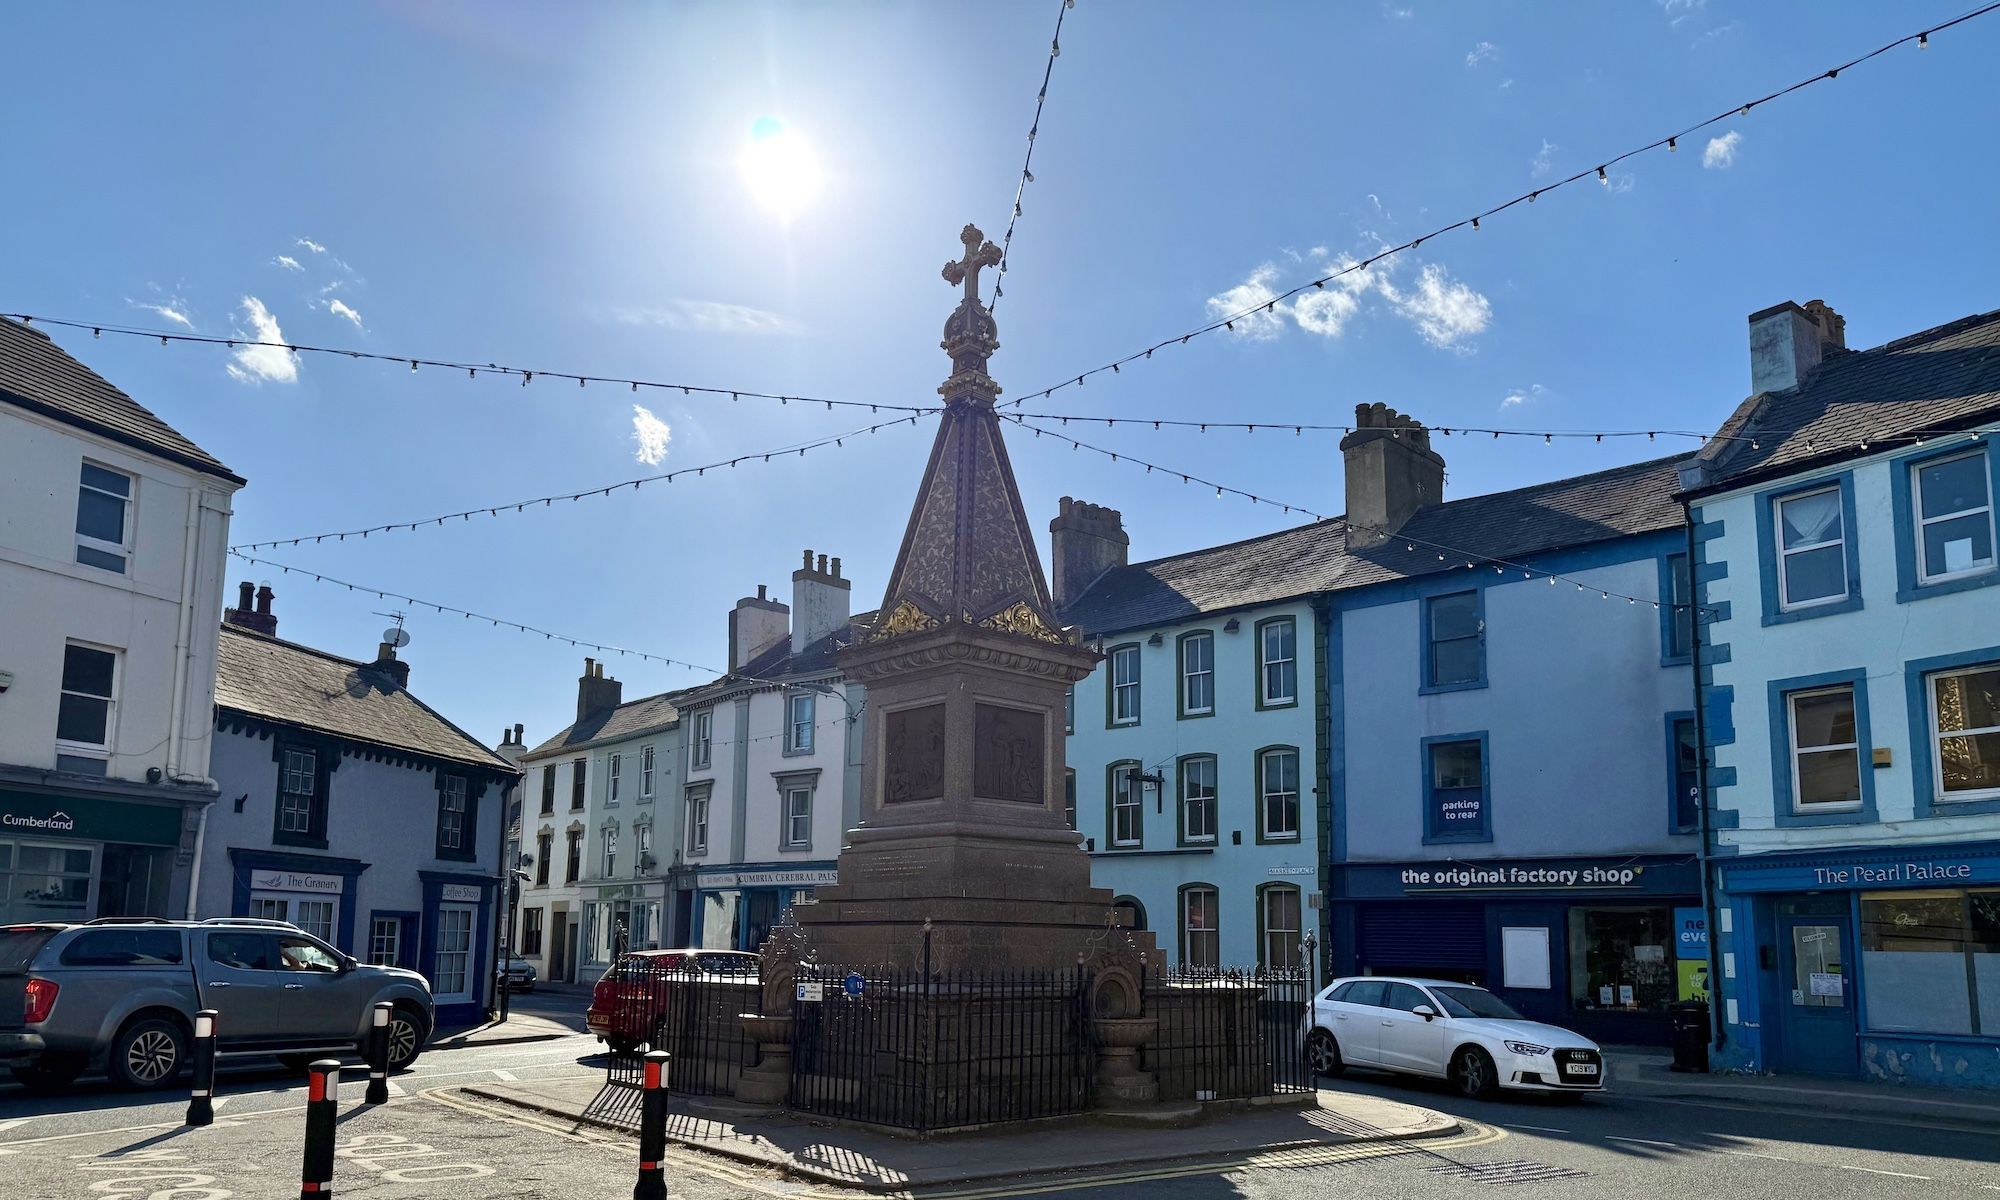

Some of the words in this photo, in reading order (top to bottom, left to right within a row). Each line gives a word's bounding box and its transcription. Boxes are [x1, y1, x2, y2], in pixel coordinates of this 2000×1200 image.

[1442, 800, 1480, 811] parking
[1445, 811, 1456, 820] to
[1457, 811, 1478, 819] rear
[2, 814, 74, 830] Cumberland
[739, 872, 773, 883] CUMBRIA
[775, 872, 815, 882] CEREBRAL
[818, 872, 839, 881] PALS
[1401, 869, 1430, 884] the
[1434, 868, 1507, 887] original
[1510, 867, 1578, 885] factory
[1582, 867, 1634, 885] shop
[1813, 867, 1849, 884] The
[1852, 864, 1901, 882] Pearl
[1905, 862, 1972, 880] Palace
[287, 874, 303, 888] The
[304, 876, 338, 891] Granary
[463, 887, 479, 900] Shop
[1685, 920, 1705, 930] ne
[1680, 932, 1706, 942] eve
[1689, 974, 1702, 982] up
